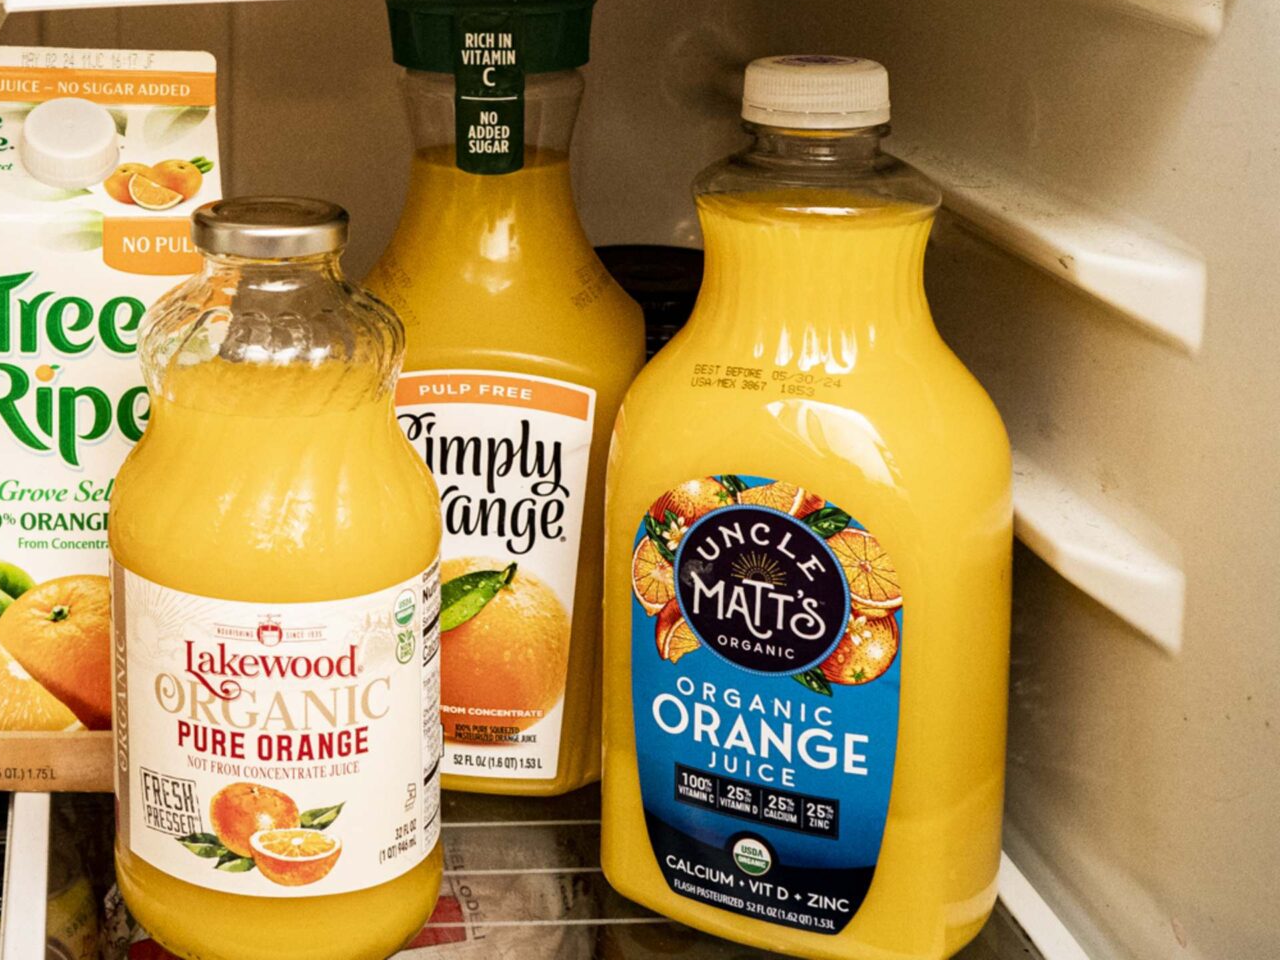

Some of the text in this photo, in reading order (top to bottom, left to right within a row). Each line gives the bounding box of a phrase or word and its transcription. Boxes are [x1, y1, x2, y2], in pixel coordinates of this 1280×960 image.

[465, 33, 512, 48] RICH IN
[461, 50, 515, 65] VITAMIN
[0, 79, 41, 93] JUICE
[57, 81, 80, 94] NO
[83, 82, 134, 95] SUGAR
[138, 83, 190, 97] ADDED
[482, 67, 496, 87] C
[480, 111, 498, 125] NO
[468, 125, 510, 139] ADDED
[468, 140, 509, 154] SUGAR
[122, 236, 150, 253] NO
[694, 364, 720, 375] BEST
[725, 366, 762, 378] BEFORE
[419, 384, 533, 401] PULP FREE
[697, 522, 826, 581] UNCLE
[690, 571, 826, 640] MATT'S
[717, 634, 795, 660] ORGANIC
[185, 640, 358, 700] Lakewood
[155, 673, 391, 731] ORGANIC
[469, 707, 544, 718] CONCENTRATE
[676, 676, 833, 726] ORGANIC
[178, 720, 368, 761] PURE ORANGE
[652, 693, 869, 775] ORANGE
[211, 760, 360, 780] FROM CONCENTRATE JUICE
[709, 751, 796, 787] JUICE
[144, 772, 194, 813] FRESH
[147, 807, 196, 835] PRESSED
[666, 855, 849, 913] CALCIUM VIT ZINC
